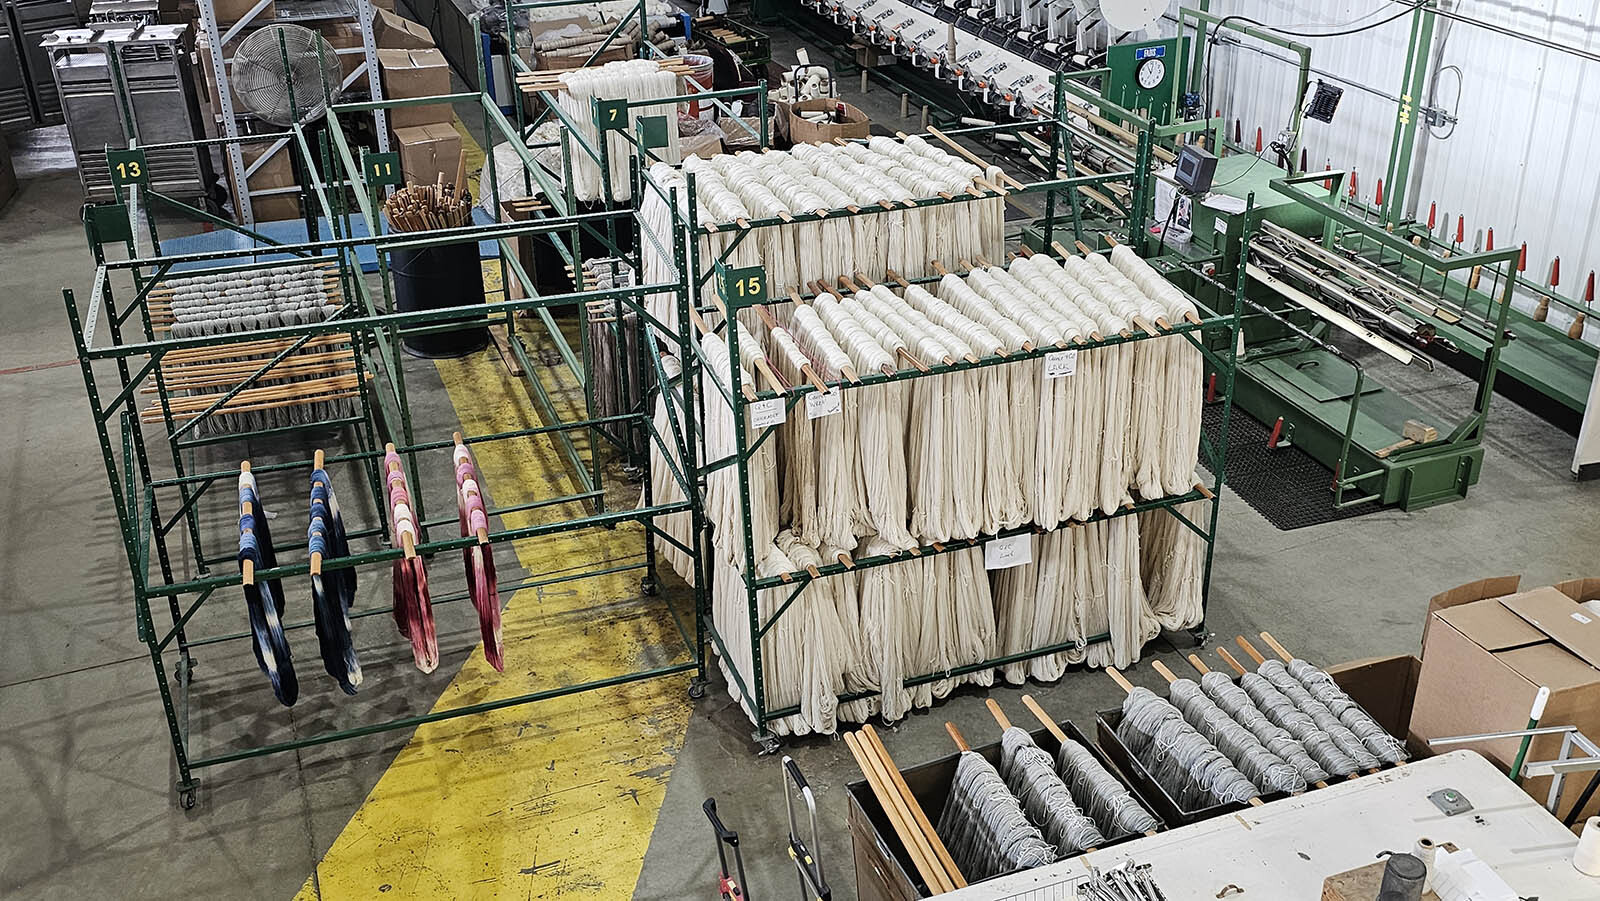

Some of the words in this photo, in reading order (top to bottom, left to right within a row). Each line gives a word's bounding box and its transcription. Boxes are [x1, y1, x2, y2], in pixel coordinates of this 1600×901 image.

[609, 108, 617, 121] 7
[116, 161, 141, 178] 13
[374, 162, 391, 177] 11
[735, 276, 761, 297] 15
